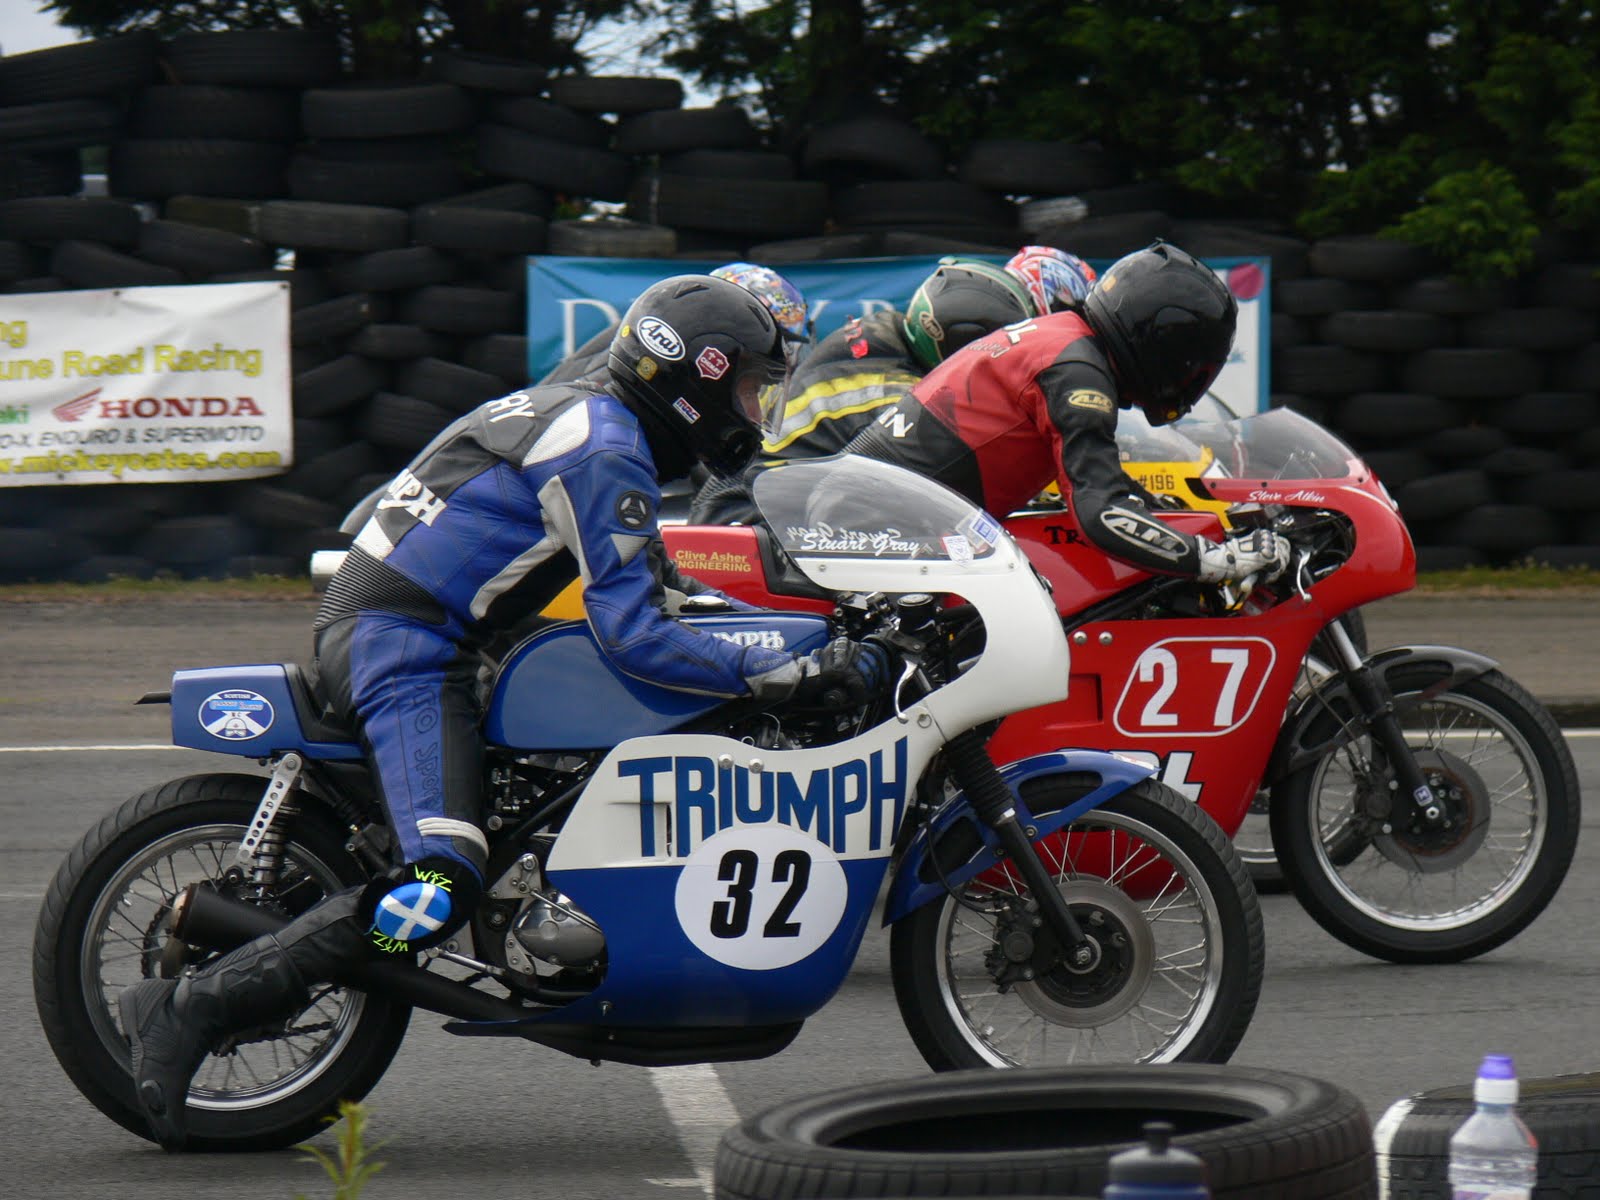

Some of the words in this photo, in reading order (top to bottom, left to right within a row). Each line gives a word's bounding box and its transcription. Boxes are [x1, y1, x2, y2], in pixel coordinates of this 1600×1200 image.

[640, 323, 681, 354] Arai
[63, 347, 145, 378] Road
[152, 343, 264, 378] Racing
[98, 397, 264, 419] HONDA
[38, 428, 121, 447] ENDURO
[125, 428, 139, 443] &
[142, 426, 264, 443] SUPERMOTO
[1246, 489, 1282, 502] Steve
[675, 549, 706, 561] Clive
[710, 551, 748, 563] Asher
[800, 532, 867, 551] Stuart
[872, 533, 921, 557] Gray
[617, 736, 908, 858] TRIUMPH
[710, 849, 812, 940] 32
